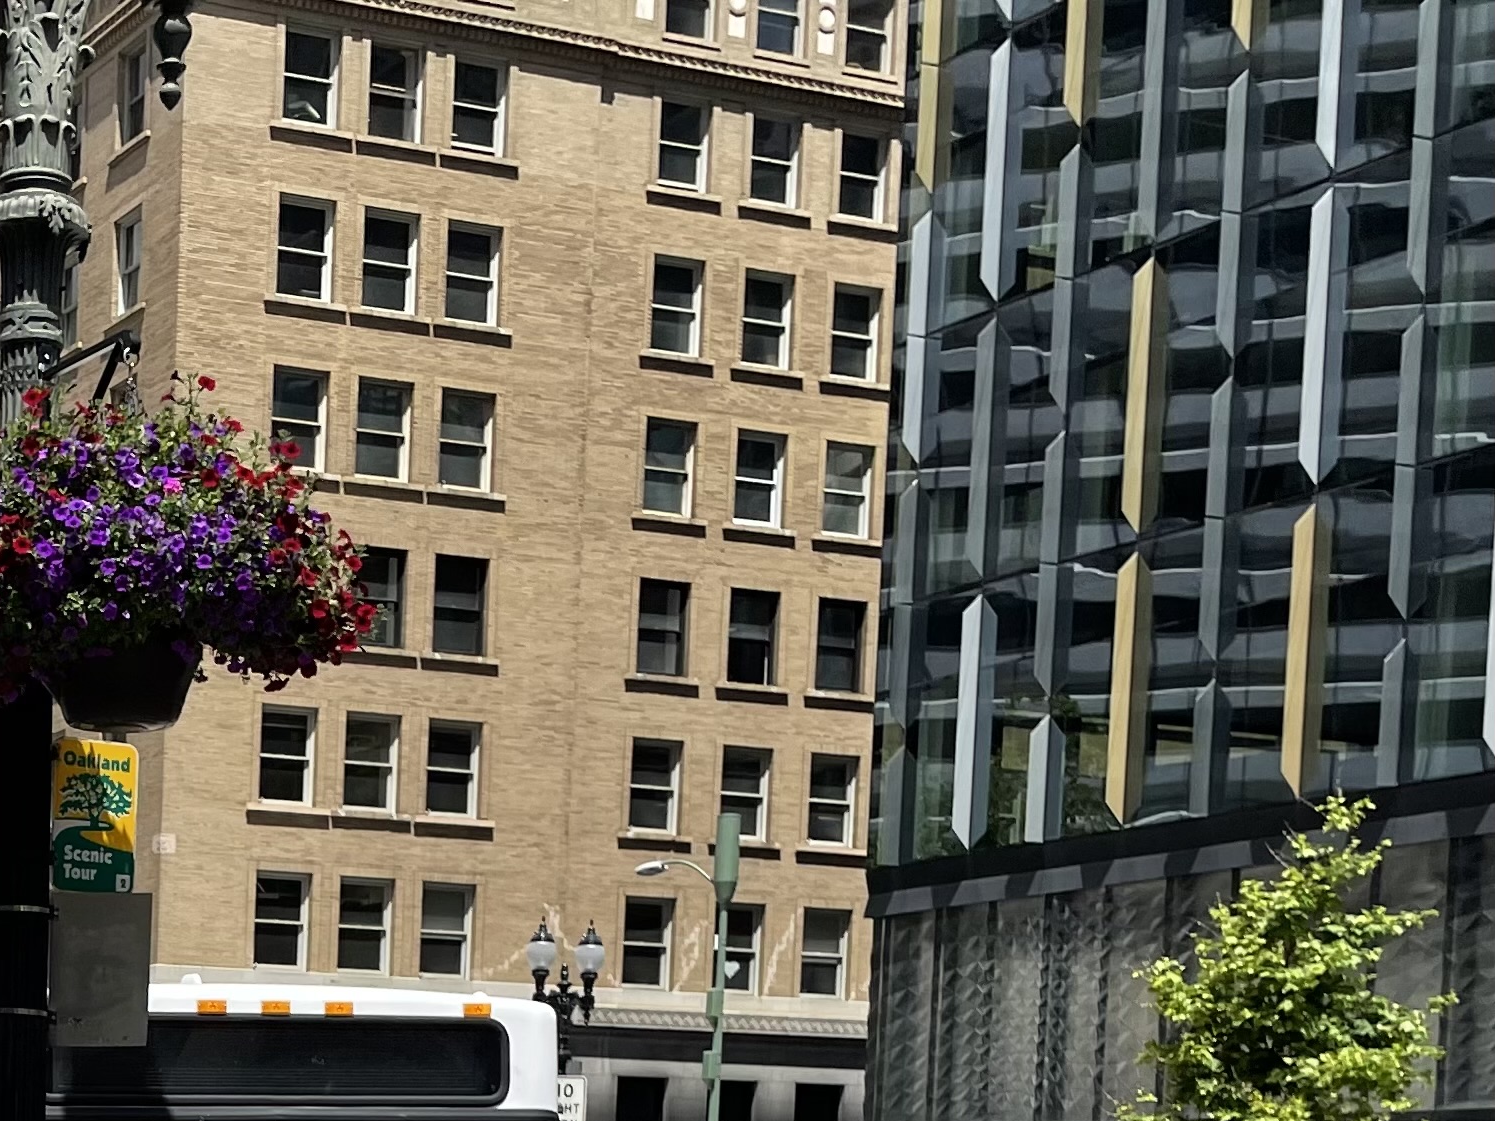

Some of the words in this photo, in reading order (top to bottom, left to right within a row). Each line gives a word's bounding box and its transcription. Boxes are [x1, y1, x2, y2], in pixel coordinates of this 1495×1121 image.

[63, 750, 131, 773] Oakland
[63, 844, 113, 865] Scenic
[63, 863, 98, 881] Tour
[120, 878, 127, 889] 2
